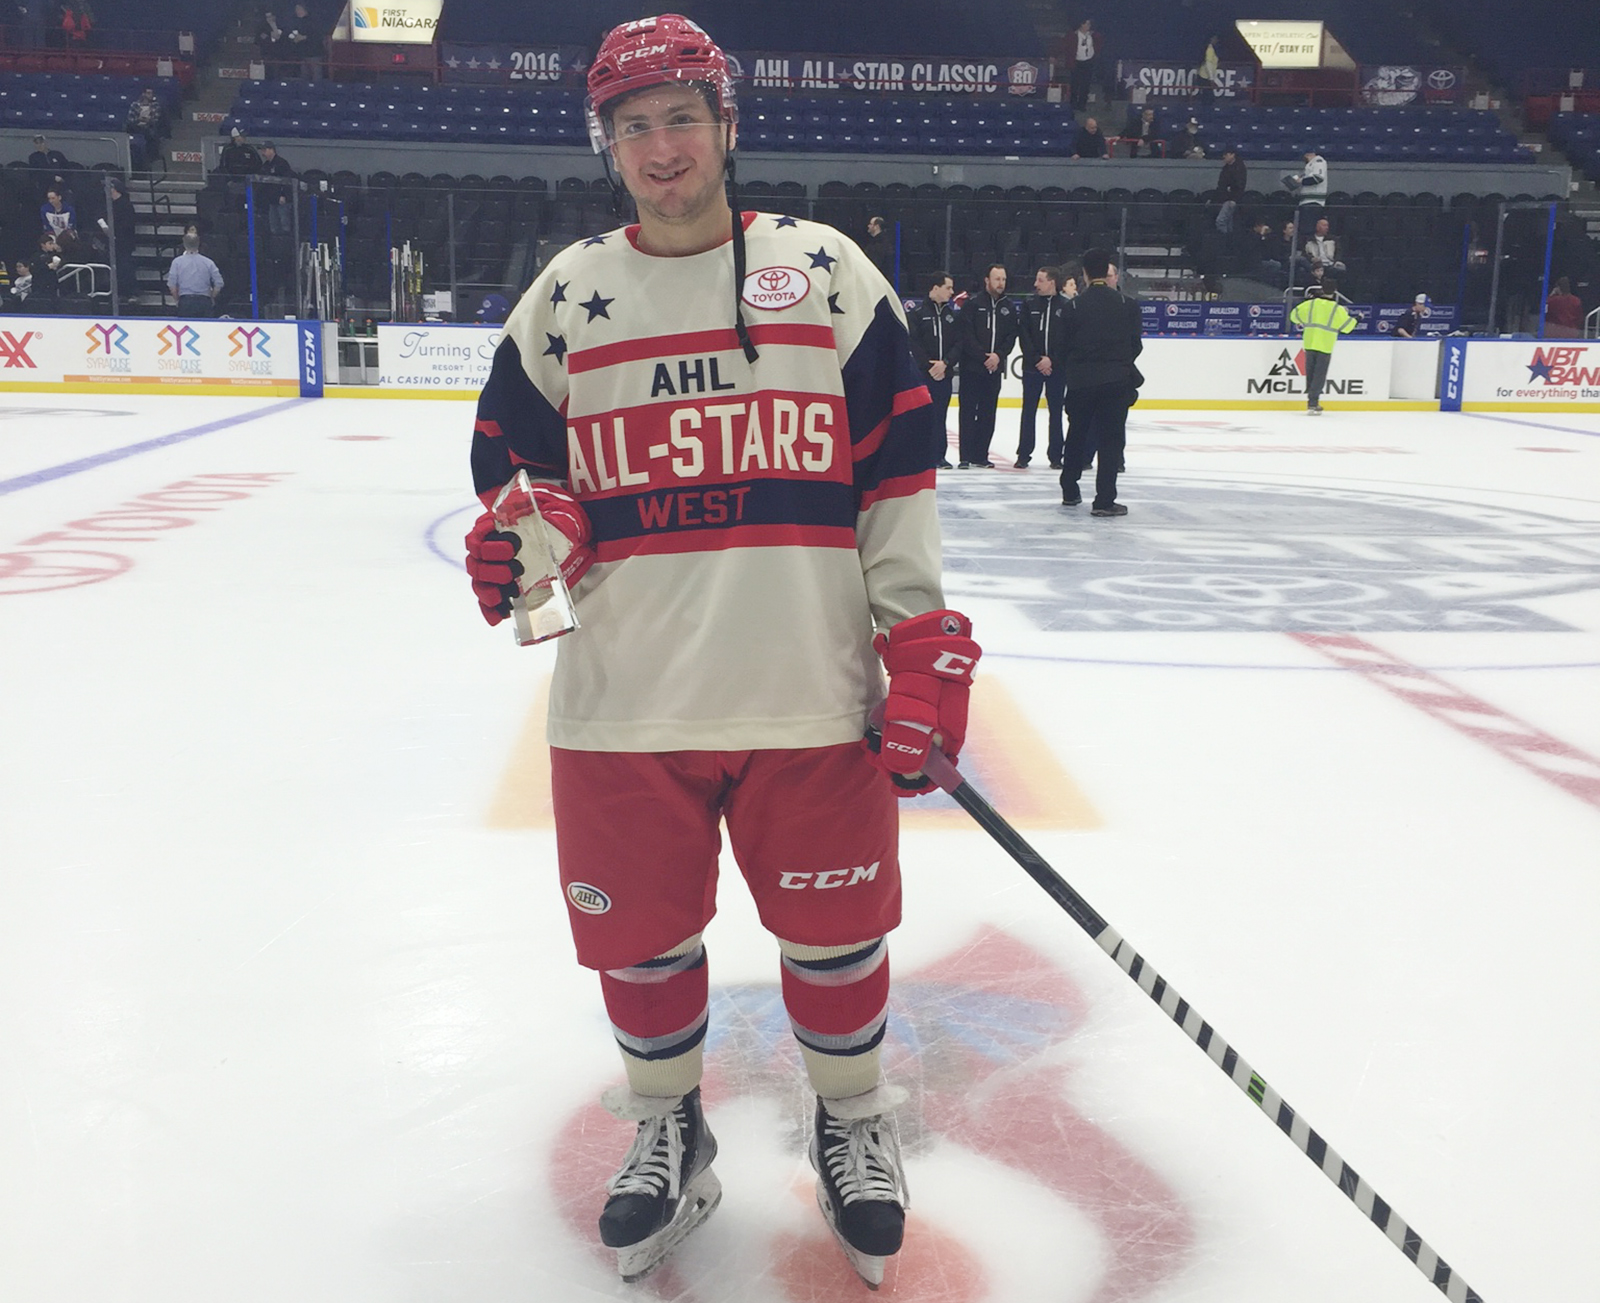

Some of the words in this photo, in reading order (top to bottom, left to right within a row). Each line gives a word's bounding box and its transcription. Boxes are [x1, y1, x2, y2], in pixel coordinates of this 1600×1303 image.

[382, 9, 406, 17] FIRST
[381, 17, 438, 29] NIAGARA
[620, 44, 667, 62] CCM
[1302, 45, 1315, 53] FIT
[510, 52, 562, 81] 2016
[753, 59, 794, 88] AHL
[801, 60, 839, 89] ALL
[853, 62, 904, 91] STAR
[911, 63, 998, 94] CLASSIC
[1013, 70, 1032, 84] 80
[1139, 67, 1237, 97] SYRACSE
[752, 291, 797, 303] TOYOTA
[399, 331, 471, 361] Turning
[86, 357, 131, 369] SYRACUSE
[158, 358, 201, 370] SYRACUSE
[304, 329, 317, 386] CCM
[1531, 347, 1589, 366] NBT
[229, 359, 272, 371] SYRACUSE
[432, 364, 464, 372] RESORT
[1447, 346, 1461, 400] CCM
[397, 376, 441, 385] CASINO
[445, 377, 460, 385] OF
[464, 377, 486, 385] THE
[651, 357, 735, 397] AHL
[1247, 379, 1364, 394] McLNE
[1496, 387, 1513, 397] for
[1516, 388, 1578, 399] everything
[567, 398, 834, 493] ALL-STARS
[15, 472, 298, 546] TOYOTA
[637, 487, 750, 529] WEST
[886, 741, 924, 756] CCM
[779, 861, 880, 890] CCM
[575, 891, 600, 907] AHL
